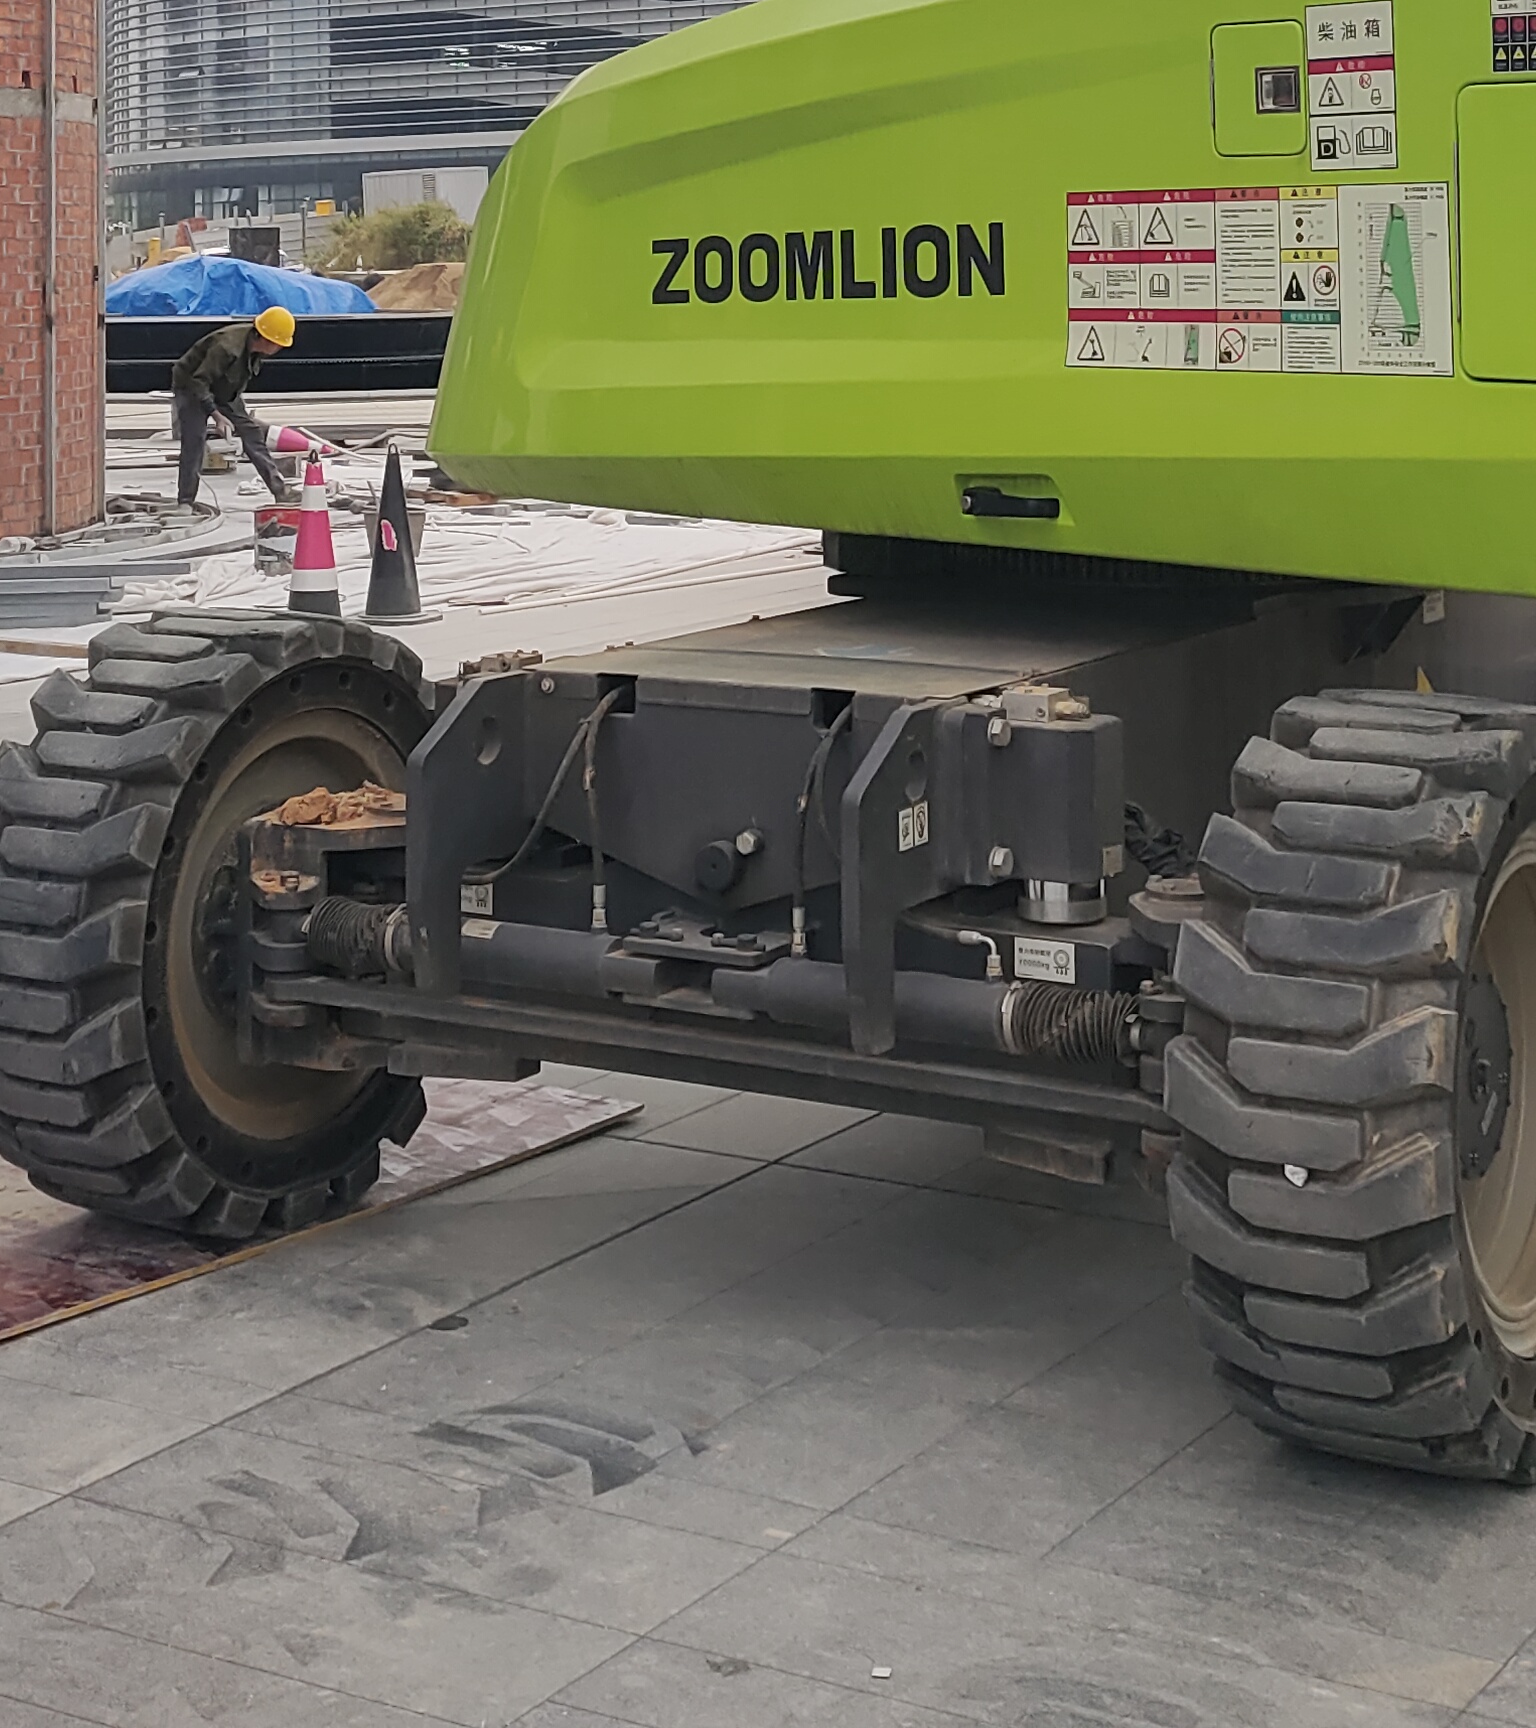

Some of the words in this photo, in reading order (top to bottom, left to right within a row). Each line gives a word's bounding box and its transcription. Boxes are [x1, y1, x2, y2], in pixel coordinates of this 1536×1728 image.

[1318, 19, 1381, 41] 柴油箱
[651, 222, 1006, 304] ZOOMLION
